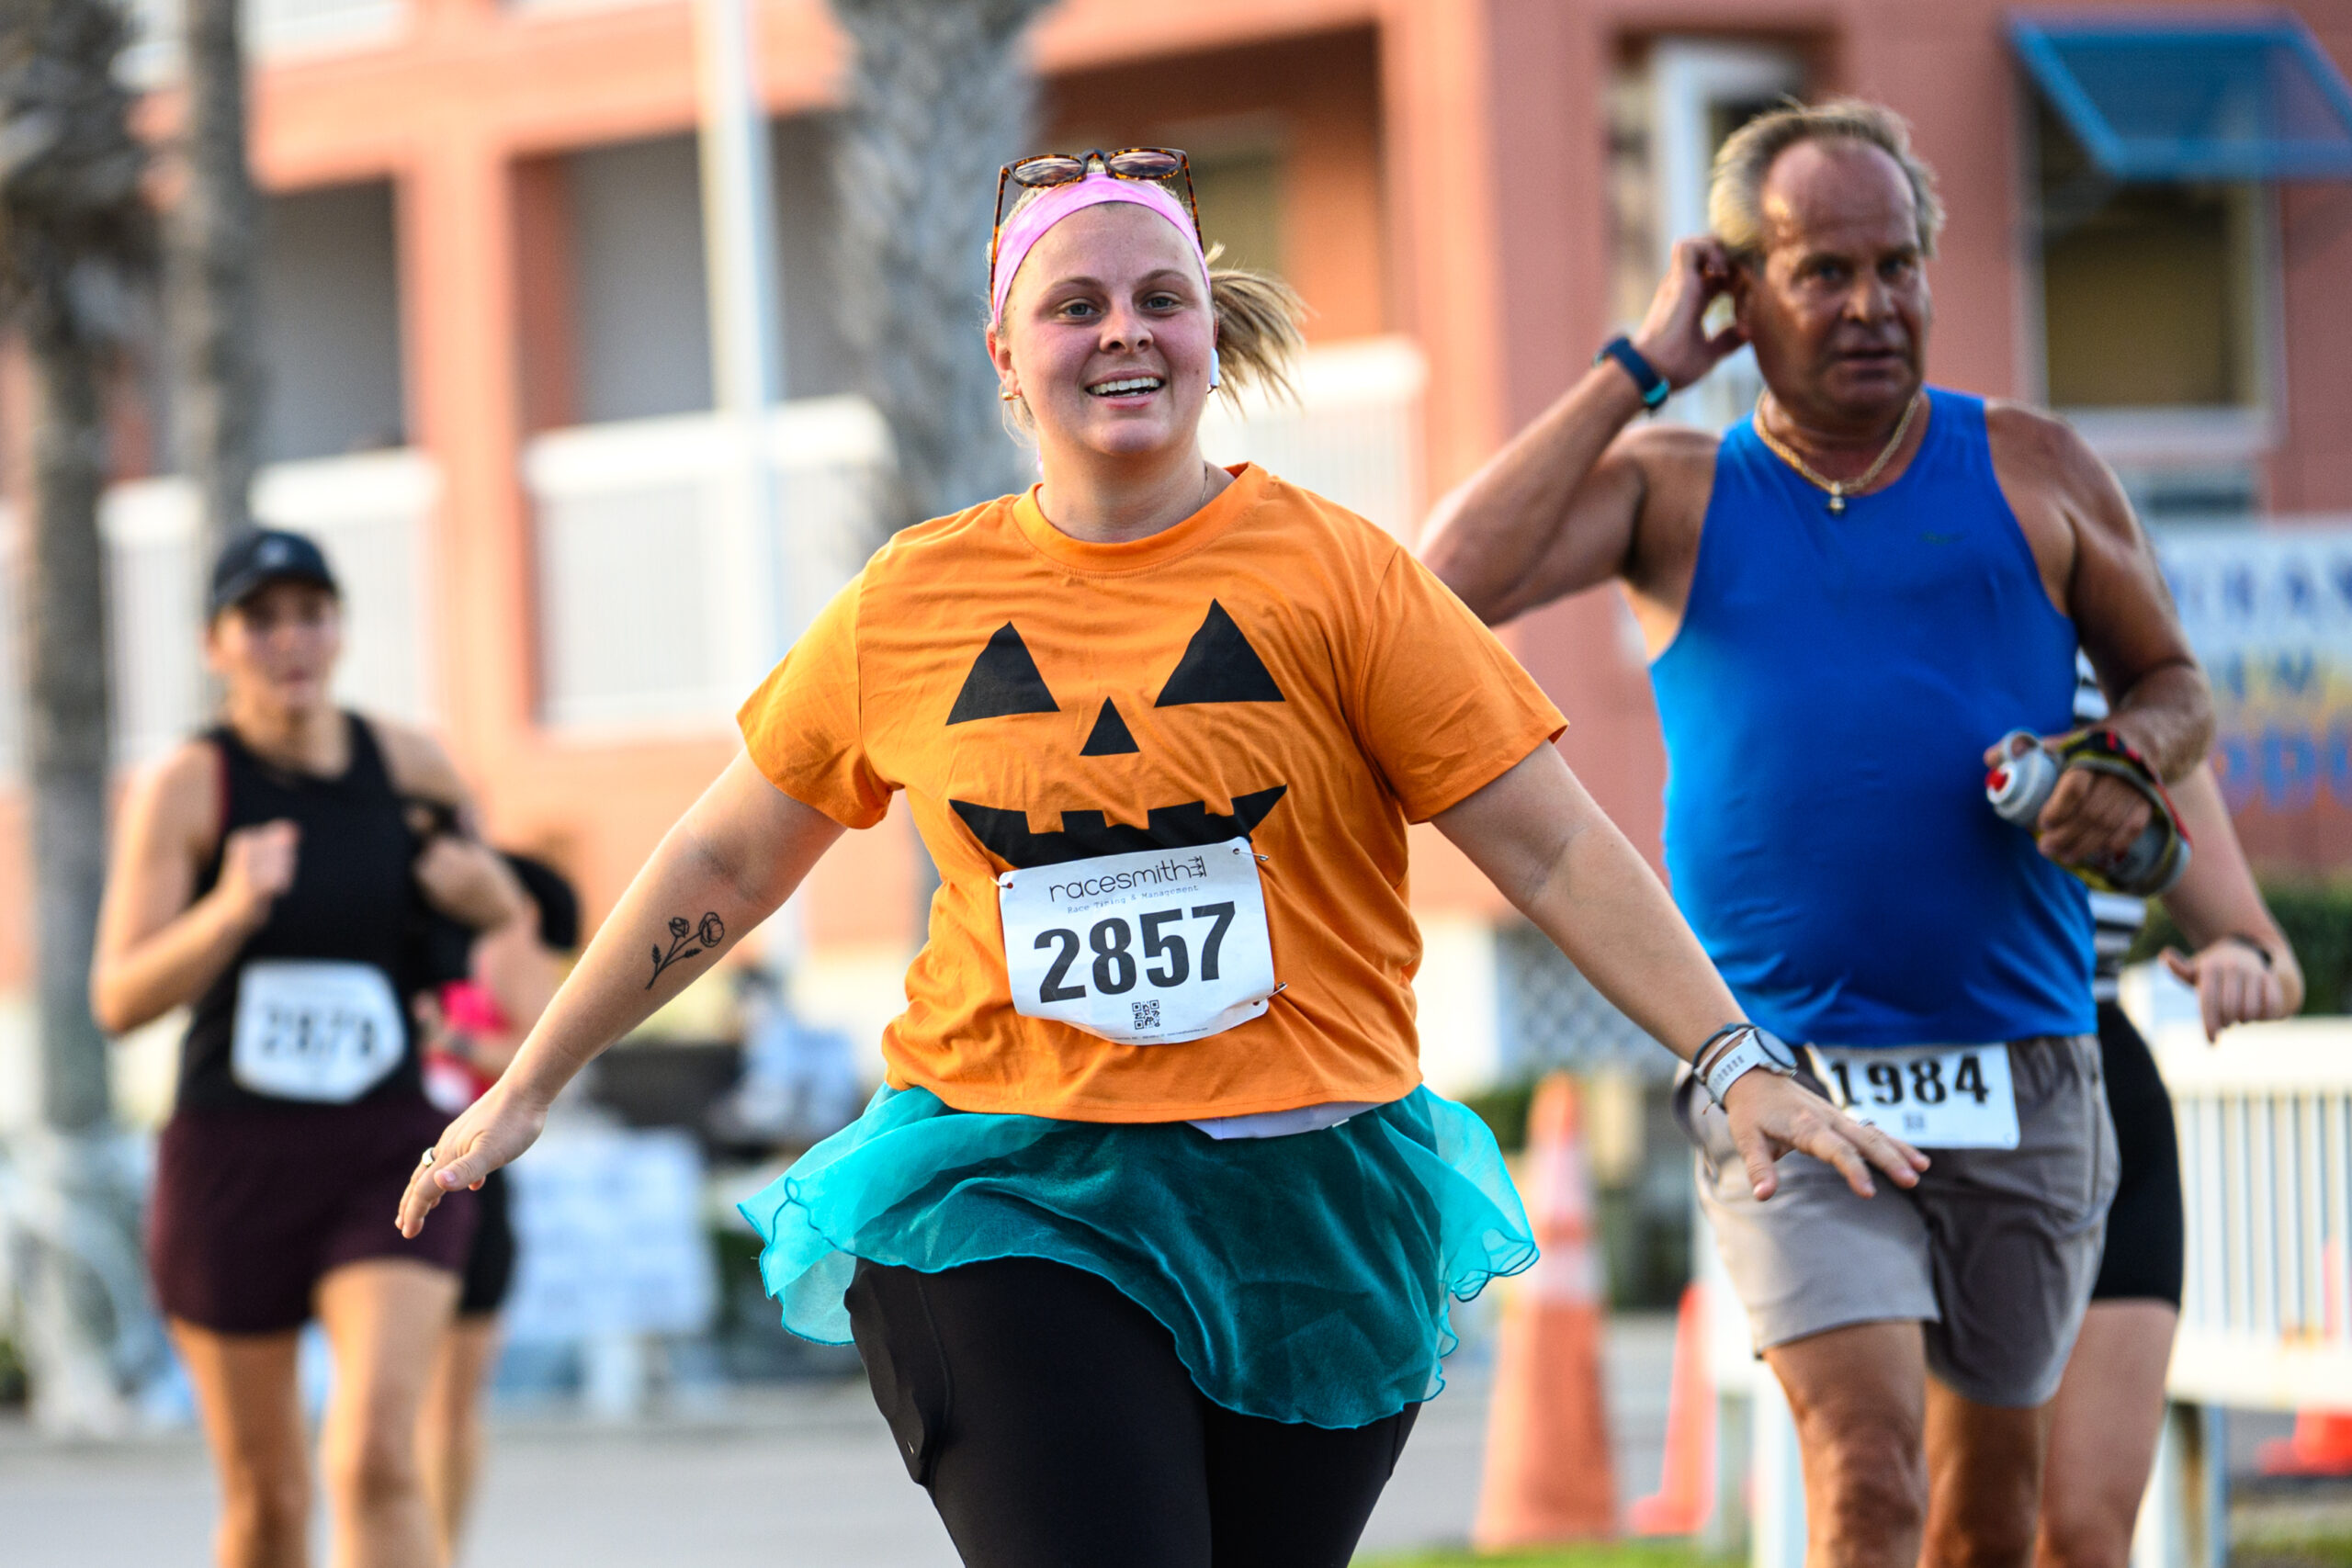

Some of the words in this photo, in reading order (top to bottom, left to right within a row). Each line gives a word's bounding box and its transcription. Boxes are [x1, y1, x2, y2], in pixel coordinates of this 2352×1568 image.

[1049, 859, 1193, 902] racesmith
[1067, 905, 1091, 915] Race
[1093, 897, 1126, 908] Timing
[1141, 885, 1199, 899] Management
[1034, 900, 1236, 1003] 2857
[1830, 1053, 1990, 1107] 1984
